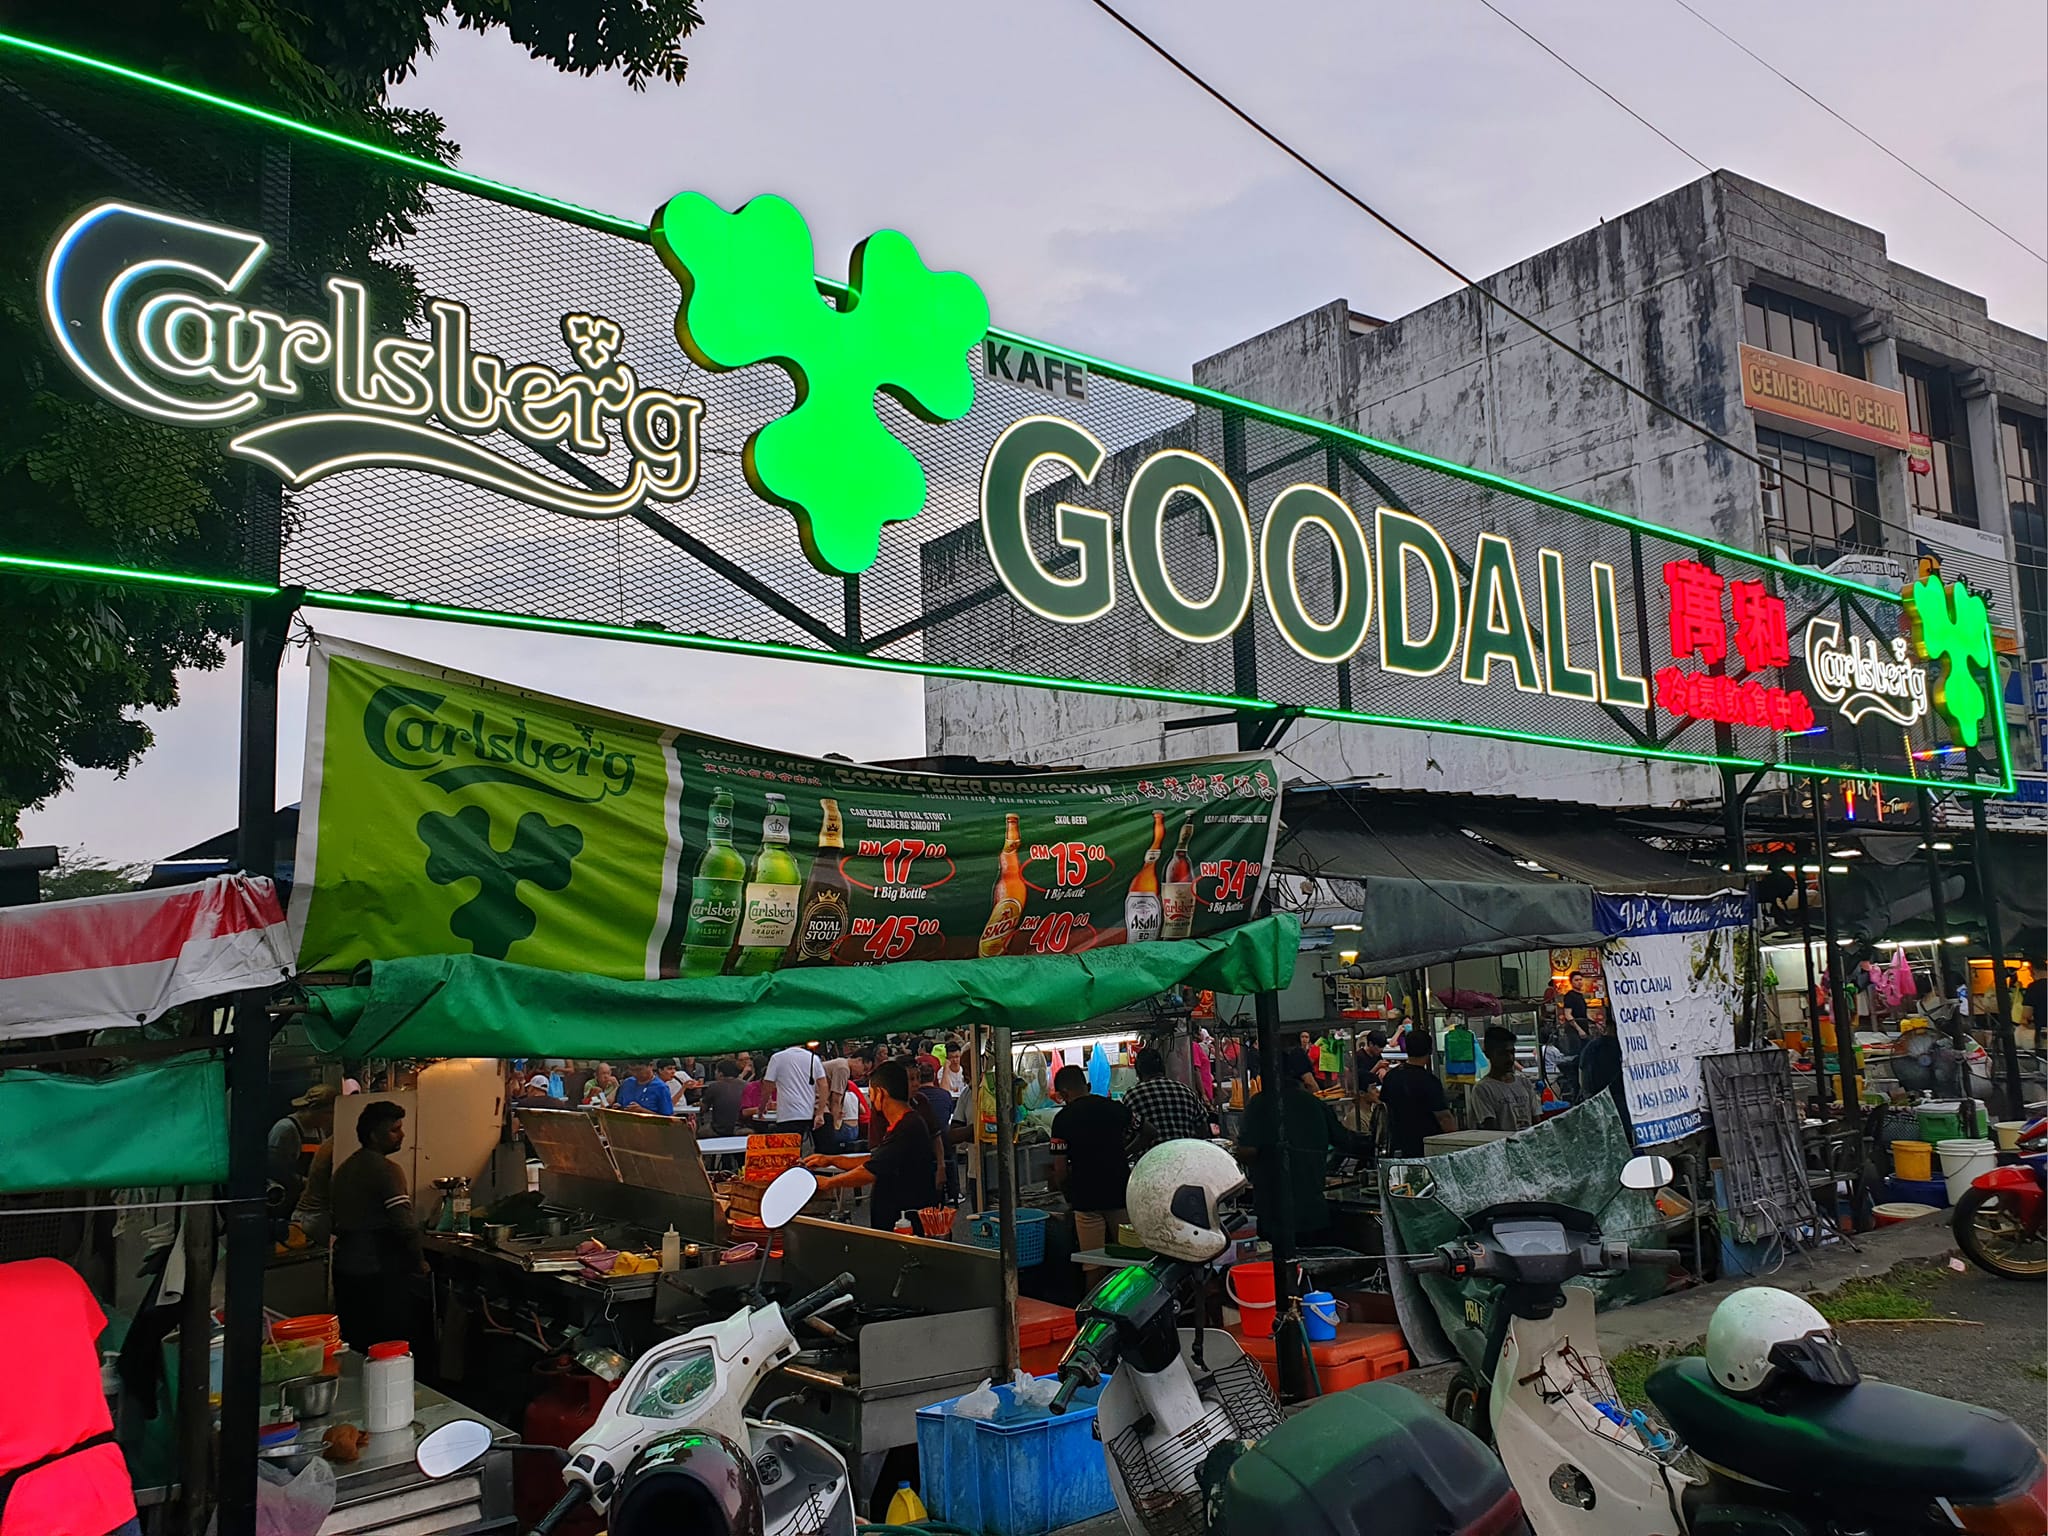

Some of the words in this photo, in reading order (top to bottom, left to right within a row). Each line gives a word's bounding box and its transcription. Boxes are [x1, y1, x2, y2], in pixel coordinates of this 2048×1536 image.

[46, 203, 704, 515] Carlsberg
[985, 339, 1087, 400] KAFE
[1748, 363, 1850, 421] CEMERLANG
[1854, 394, 1901, 434] CERIA
[981, 414, 1650, 710] GOODALL
[1662, 559, 1790, 673] 萬和
[1805, 616, 1929, 727] Carlsberg
[1655, 665, 1815, 732] 冷氣飲食中心
[363, 684, 636, 804] Carlsberg
[867, 818, 909, 830] CARLSBERG
[910, 820, 941, 832] SMOOTH
[1054, 815, 1071, 824] SKOL
[1071, 816, 1087, 825] BEER
[858, 840, 881, 856] RM
[1029, 844, 1050, 860] RM
[1200, 861, 1218, 877] RM
[881, 886, 898, 901] Big
[899, 886, 927, 899] Bottle
[749, 900, 795, 926] Carlsberg
[1163, 897, 1194, 921] Carlsber
[1662, 899, 1711, 927] Indian
[808, 920, 841, 932] ROYAL
[851, 918, 876, 936] RM
[1020, 915, 1041, 930] RM
[1131, 914, 1159, 929] Asahi
[751, 928, 785, 936] DRAUGHT
[804, 930, 840, 942] STOUT
[1613, 979, 1639, 995] ROTI
[1640, 976, 1672, 994] CANAI
[1619, 1006, 1656, 1024] CAPATI
